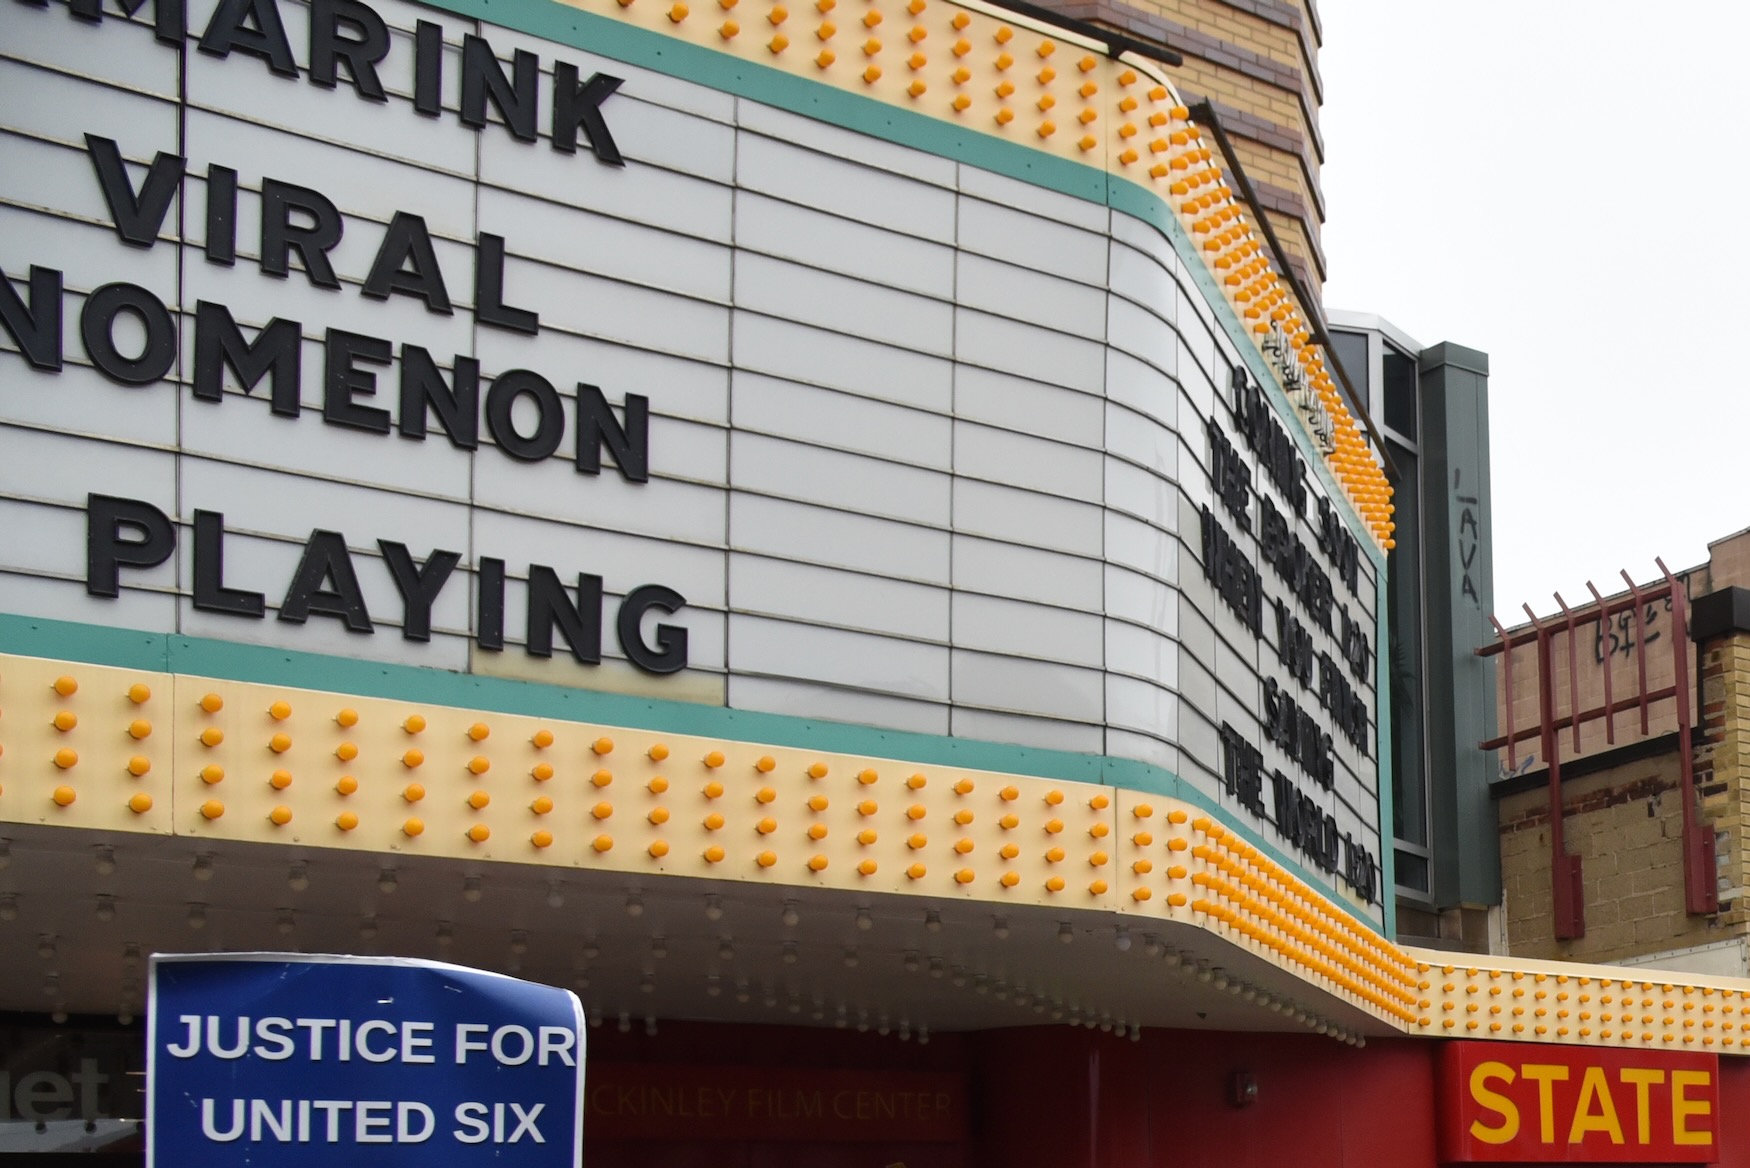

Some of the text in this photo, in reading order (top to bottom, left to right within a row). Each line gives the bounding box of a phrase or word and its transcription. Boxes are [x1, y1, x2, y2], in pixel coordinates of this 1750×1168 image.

[84, 133, 540, 336] VIRAL
[1209, 415, 1252, 530] THE
[87, 492, 689, 674] PLAYING
[1276, 597, 1313, 690] YOU
[1220, 720, 1265, 819] THE
[166, 1013, 577, 1068] JUSTICE FOR
[201, 1098, 547, 1144] UNITED SIX
[748, 1089, 823, 1119] FILM
[833, 1090, 952, 1121] CENTER
[1469, 1061, 1714, 1145] STATE
